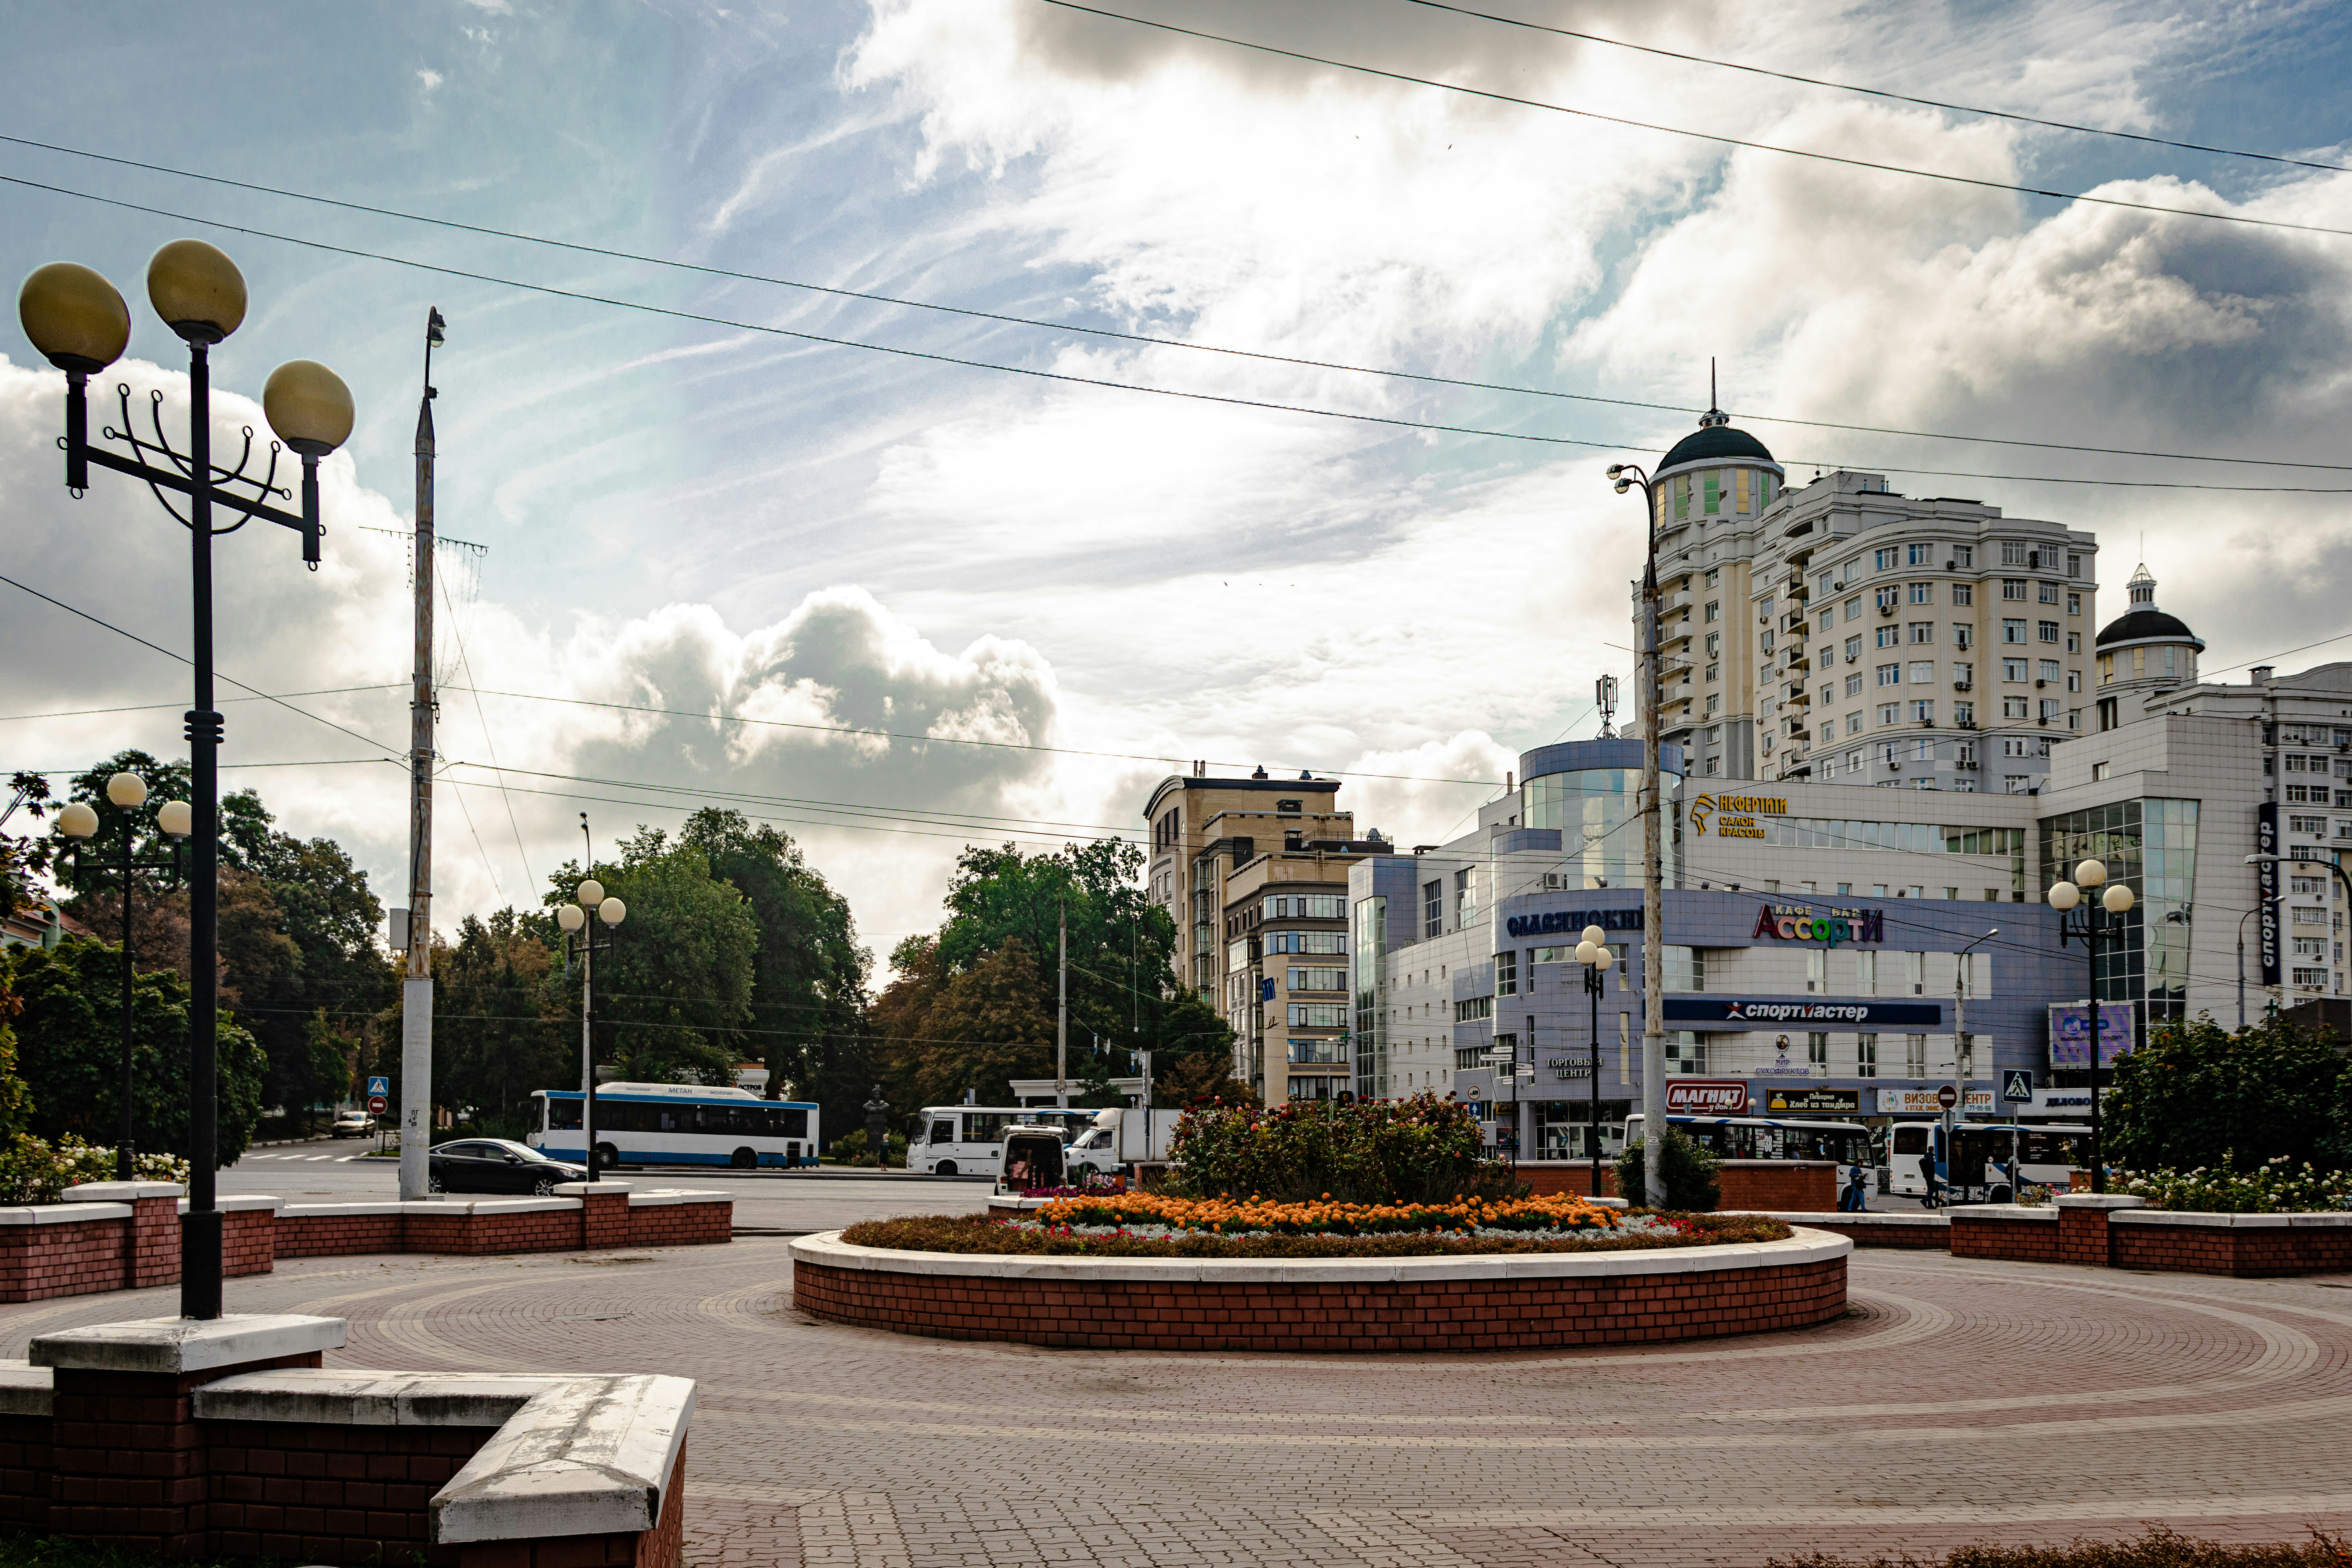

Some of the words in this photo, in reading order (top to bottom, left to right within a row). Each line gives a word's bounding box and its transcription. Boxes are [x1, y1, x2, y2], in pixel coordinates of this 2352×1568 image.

[1719, 795, 1787, 813] НЕФЕРТИТИ
[1719, 816, 1755, 827] САЛОН
[1719, 827, 1765, 838] КРАСОТЫ
[1775, 905, 1812, 915] КАФЕ
[1832, 908, 1860, 917] БАР
[1556, 1069, 1591, 1078] ЦЕНТР
[1671, 1089, 1741, 1103] МАГНИТ
[1809, 1092, 1835, 1100] Пекарня
[1905, 1093, 1938, 1104] ВИЗОВ
[1964, 1094, 1991, 1105] ЕНТР
[1789, 1098, 1809, 1108] Хлеб
[1821, 1098, 1855, 1109] тандыра
